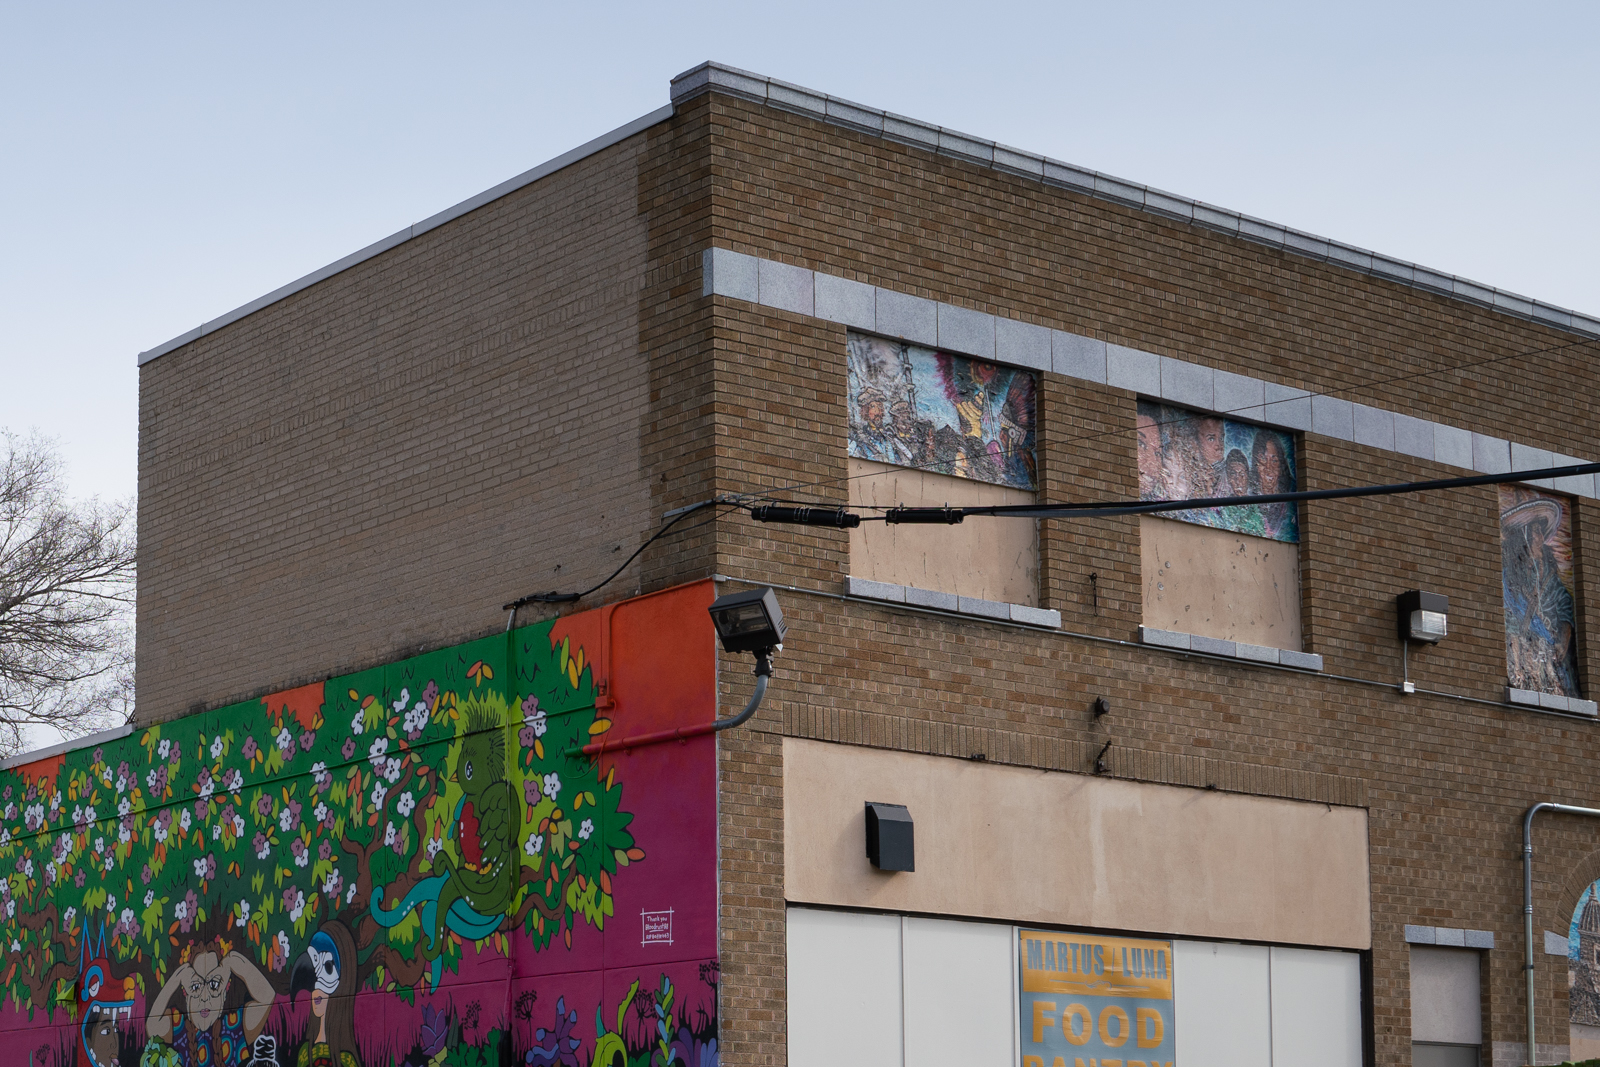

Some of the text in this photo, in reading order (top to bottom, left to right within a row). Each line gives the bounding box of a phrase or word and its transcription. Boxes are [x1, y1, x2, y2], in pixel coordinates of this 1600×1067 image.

[1026, 939, 1104, 976] MARTUS
[1122, 947, 1168, 980] LUNA
[1032, 1001, 1164, 1049] FOOD
